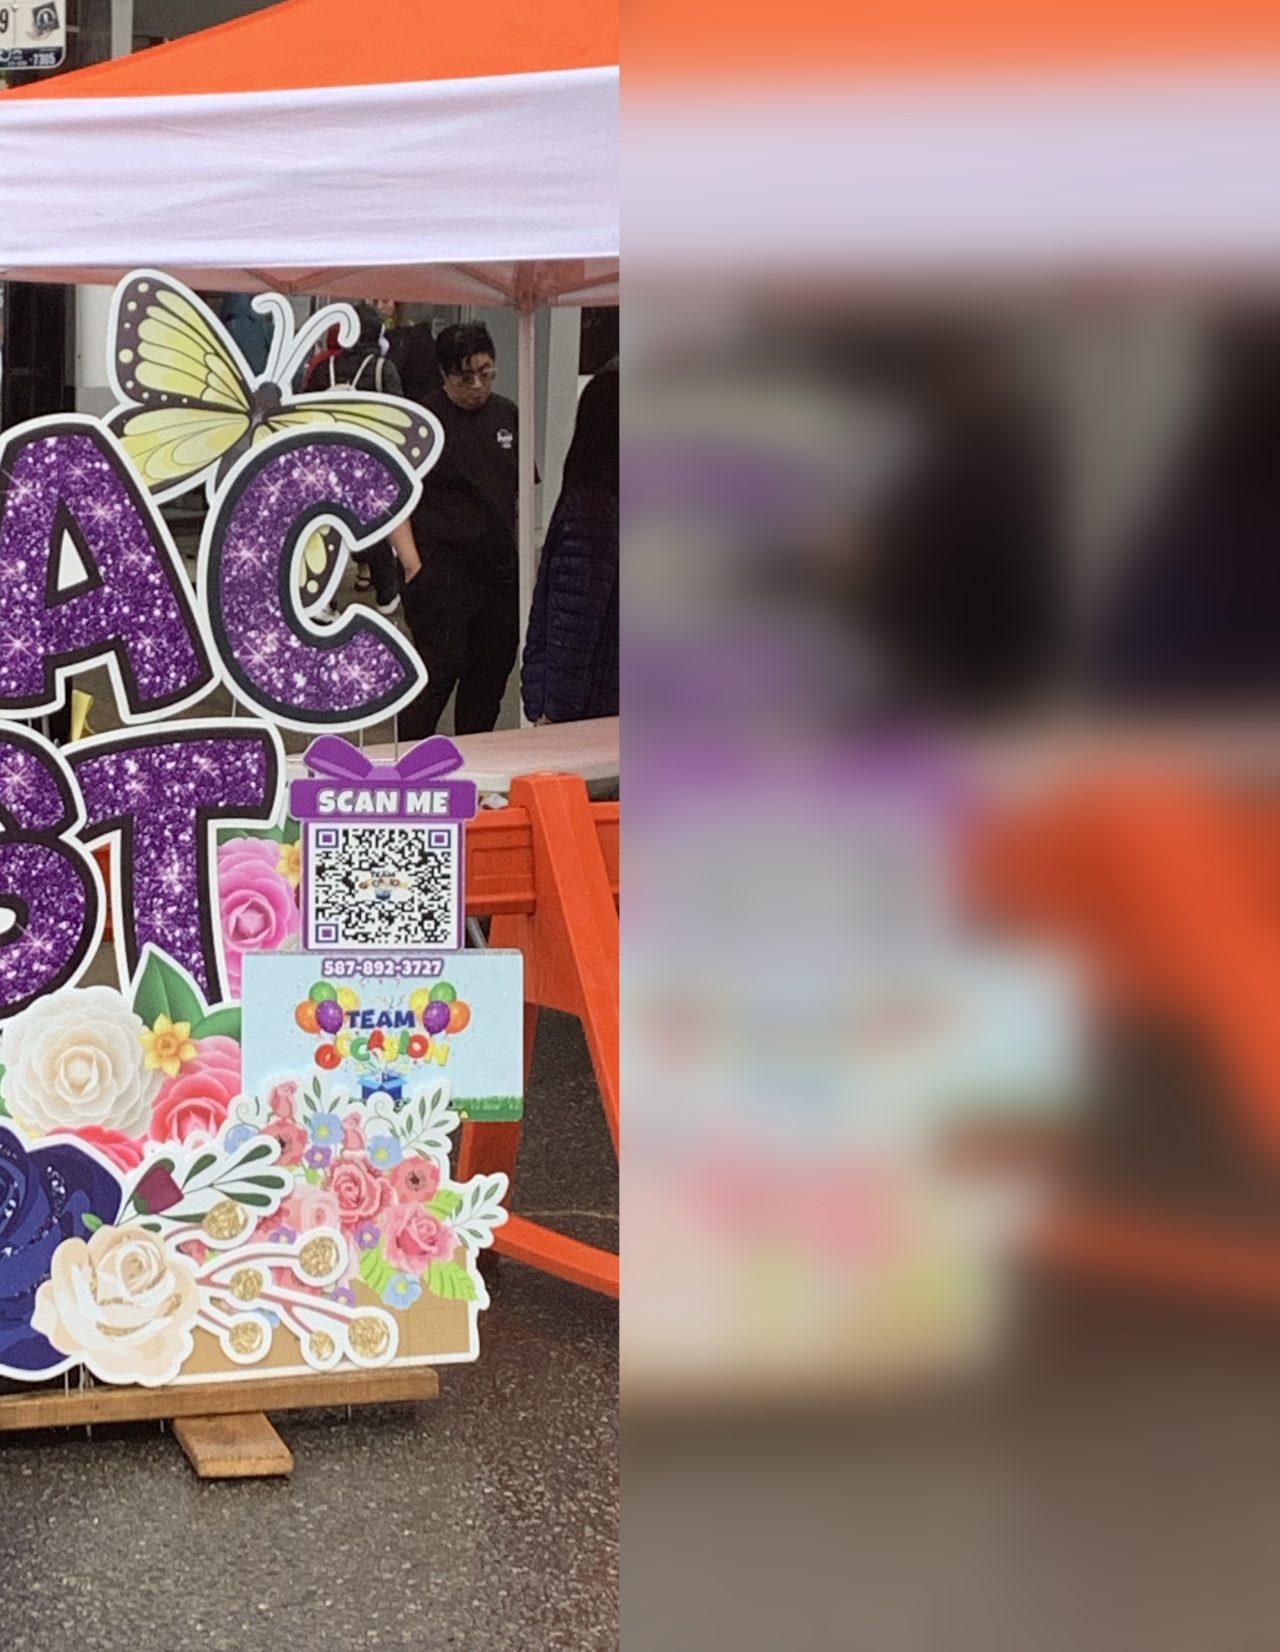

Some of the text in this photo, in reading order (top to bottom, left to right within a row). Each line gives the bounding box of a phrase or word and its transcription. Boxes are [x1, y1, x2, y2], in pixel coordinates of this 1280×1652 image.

[318, 790, 449, 814] SCAN ME
[322, 958, 444, 977] 587-892-3727
[346, 1008, 415, 1030] TEAM
[314, 1030, 449, 1069] OCCASION
